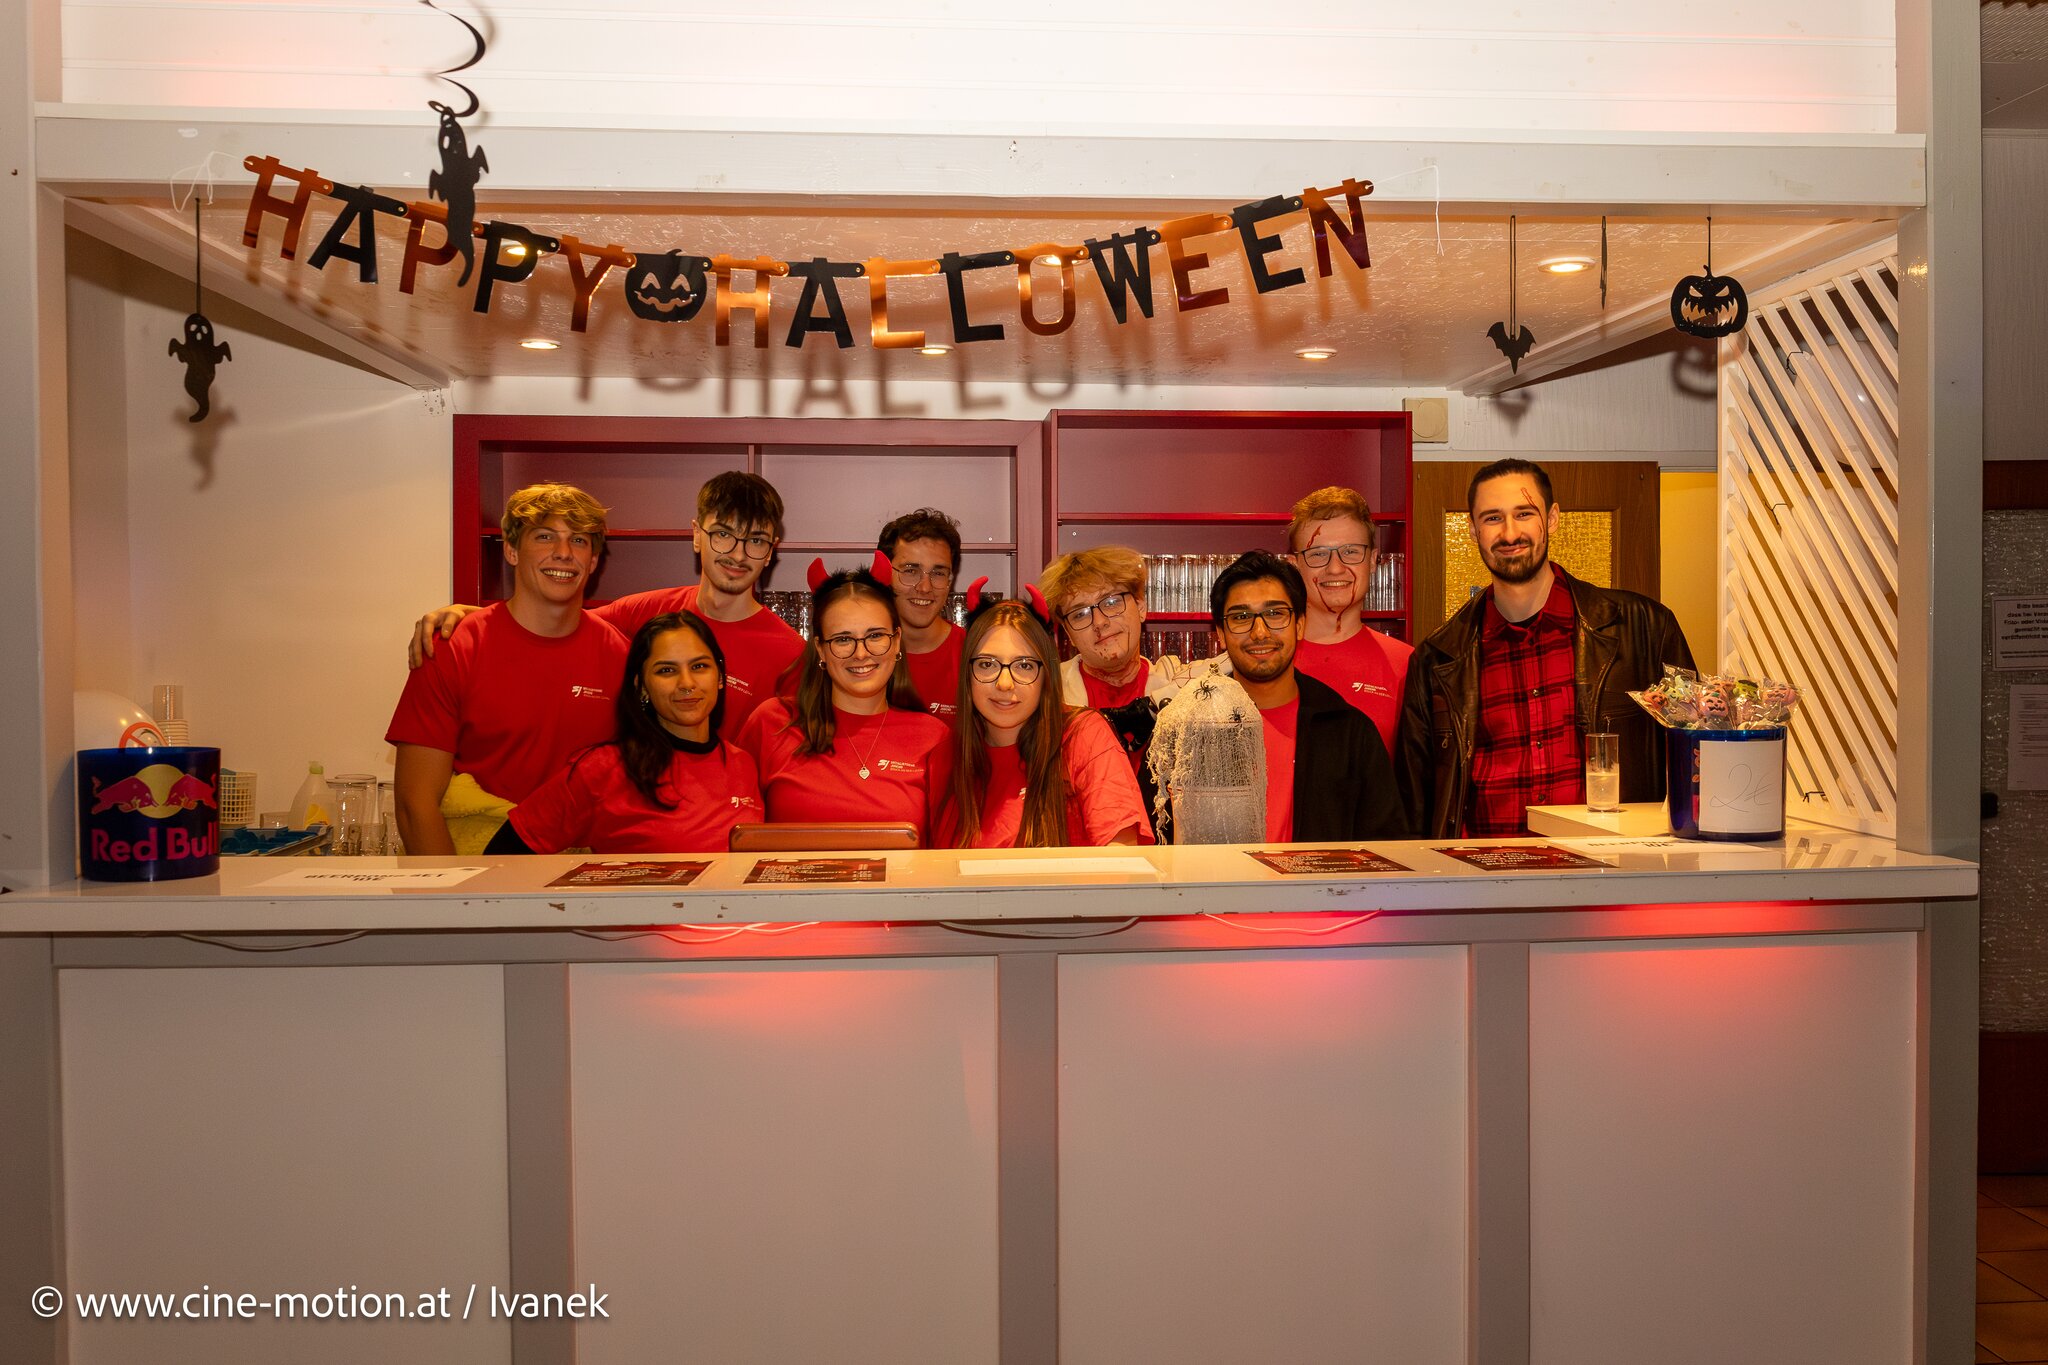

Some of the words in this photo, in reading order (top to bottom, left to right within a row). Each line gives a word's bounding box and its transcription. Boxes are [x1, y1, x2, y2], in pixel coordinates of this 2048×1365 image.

[242, 155, 628, 333] HAPPY
[715, 178, 1371, 349] HALLOWEEN
[91, 827, 158, 863] Red
[167, 822, 218, 860] Bull
